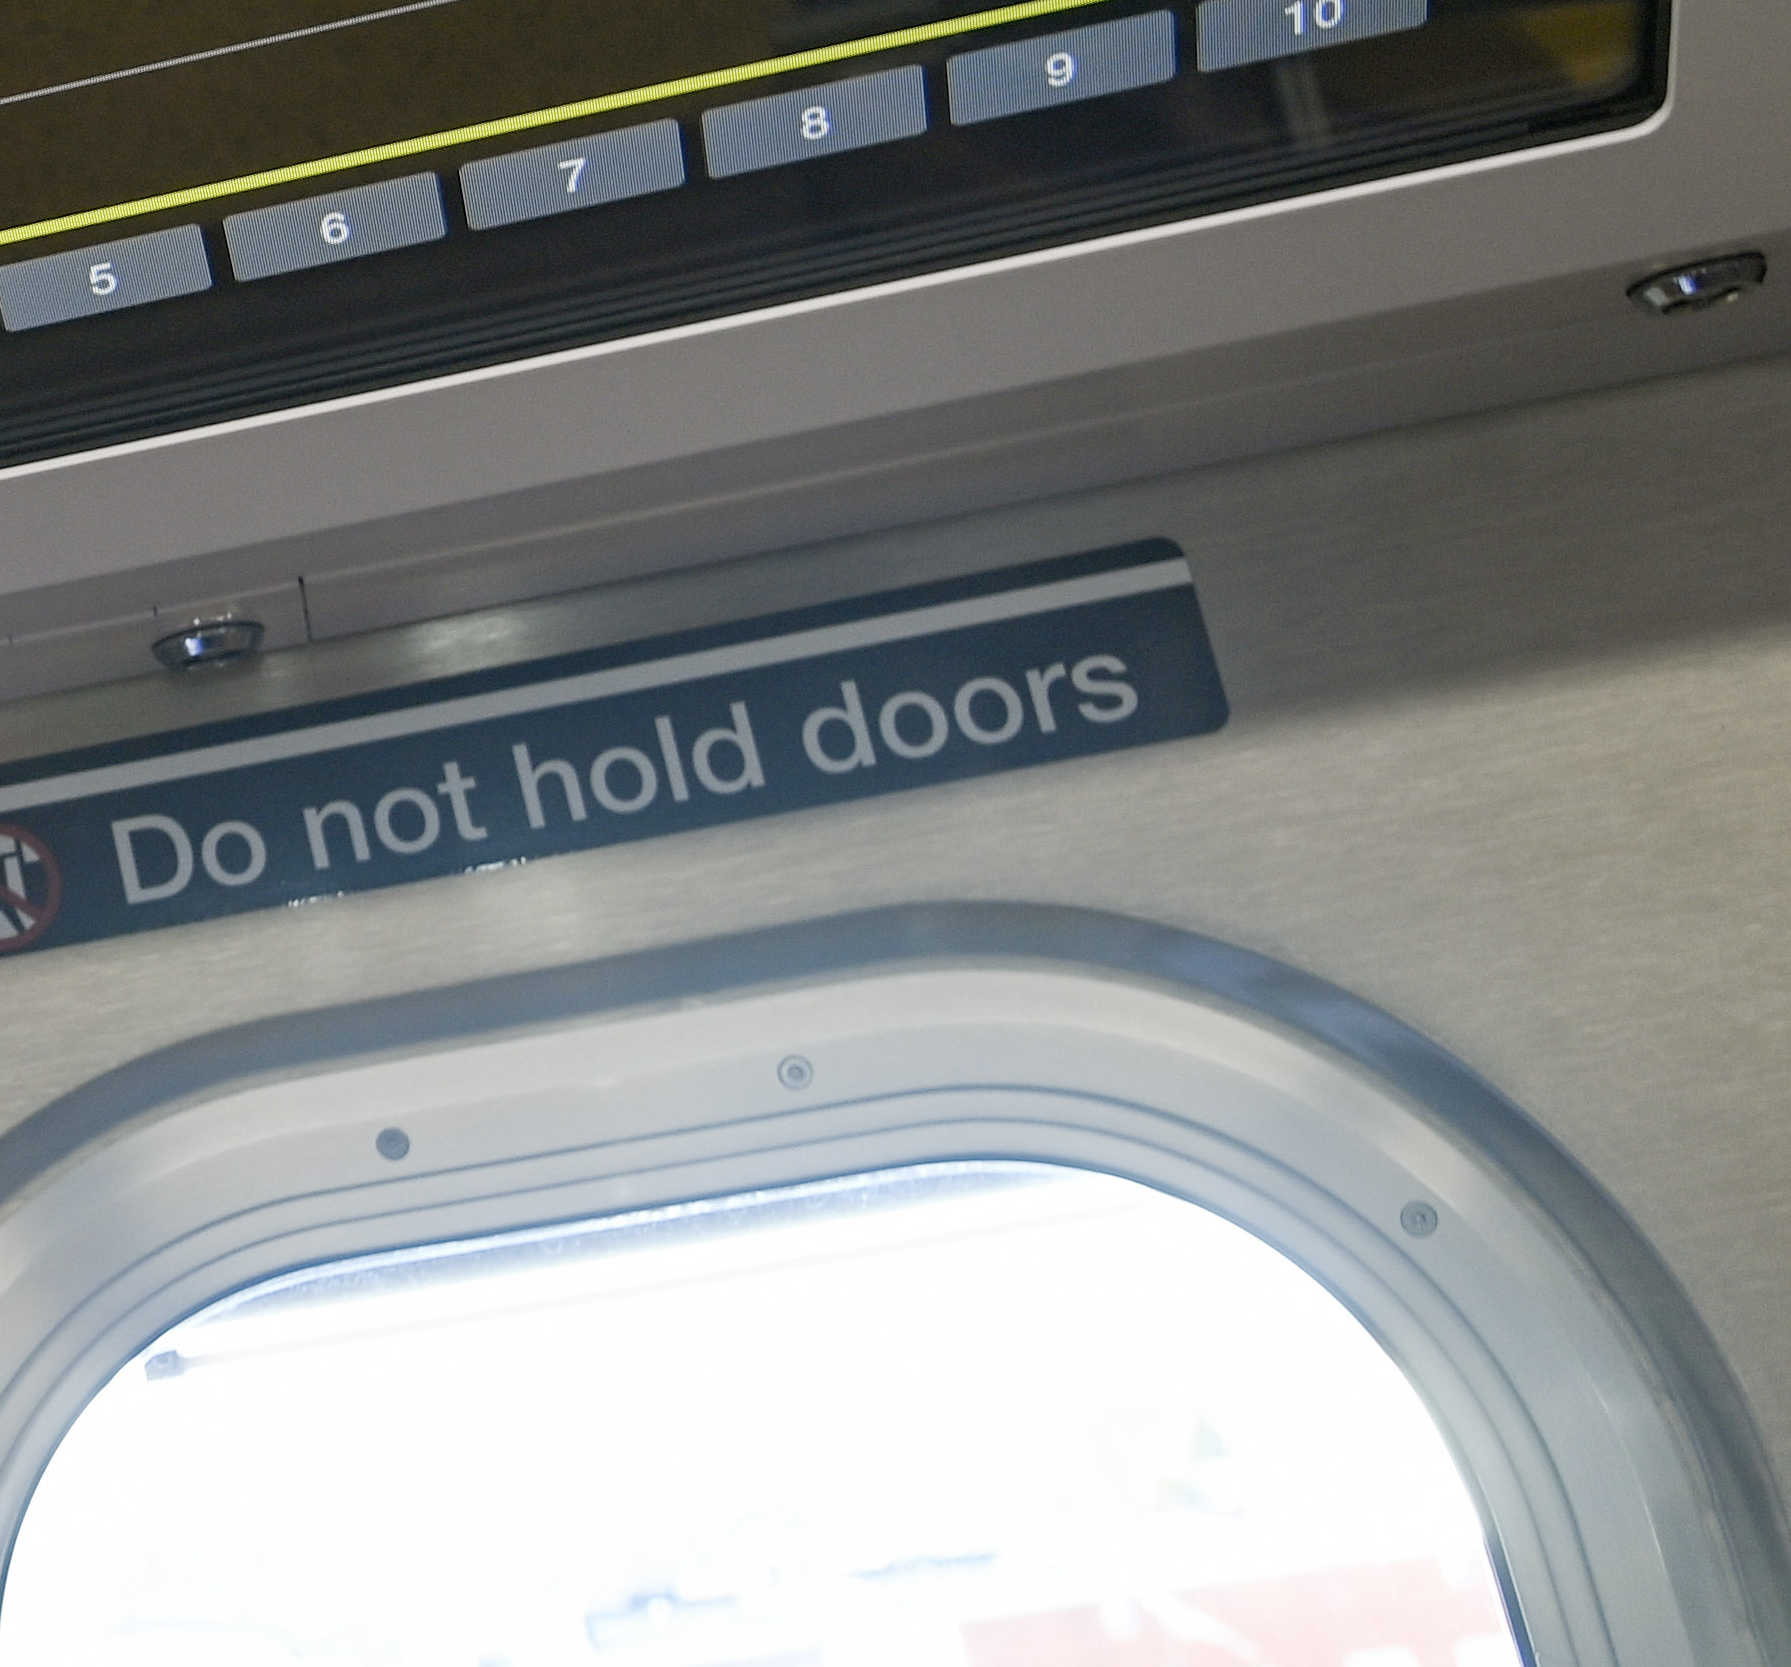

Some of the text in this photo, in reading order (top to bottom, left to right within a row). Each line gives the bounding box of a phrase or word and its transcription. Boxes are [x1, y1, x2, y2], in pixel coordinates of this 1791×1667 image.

[88, 263, 118, 297] 5
[319, 212, 350, 246] 6
[557, 157, 587, 193] 7
[800, 105, 830, 141] 8
[1044, 52, 1075, 88] 9
[109, 652, 1139, 906] Do not hold doors
